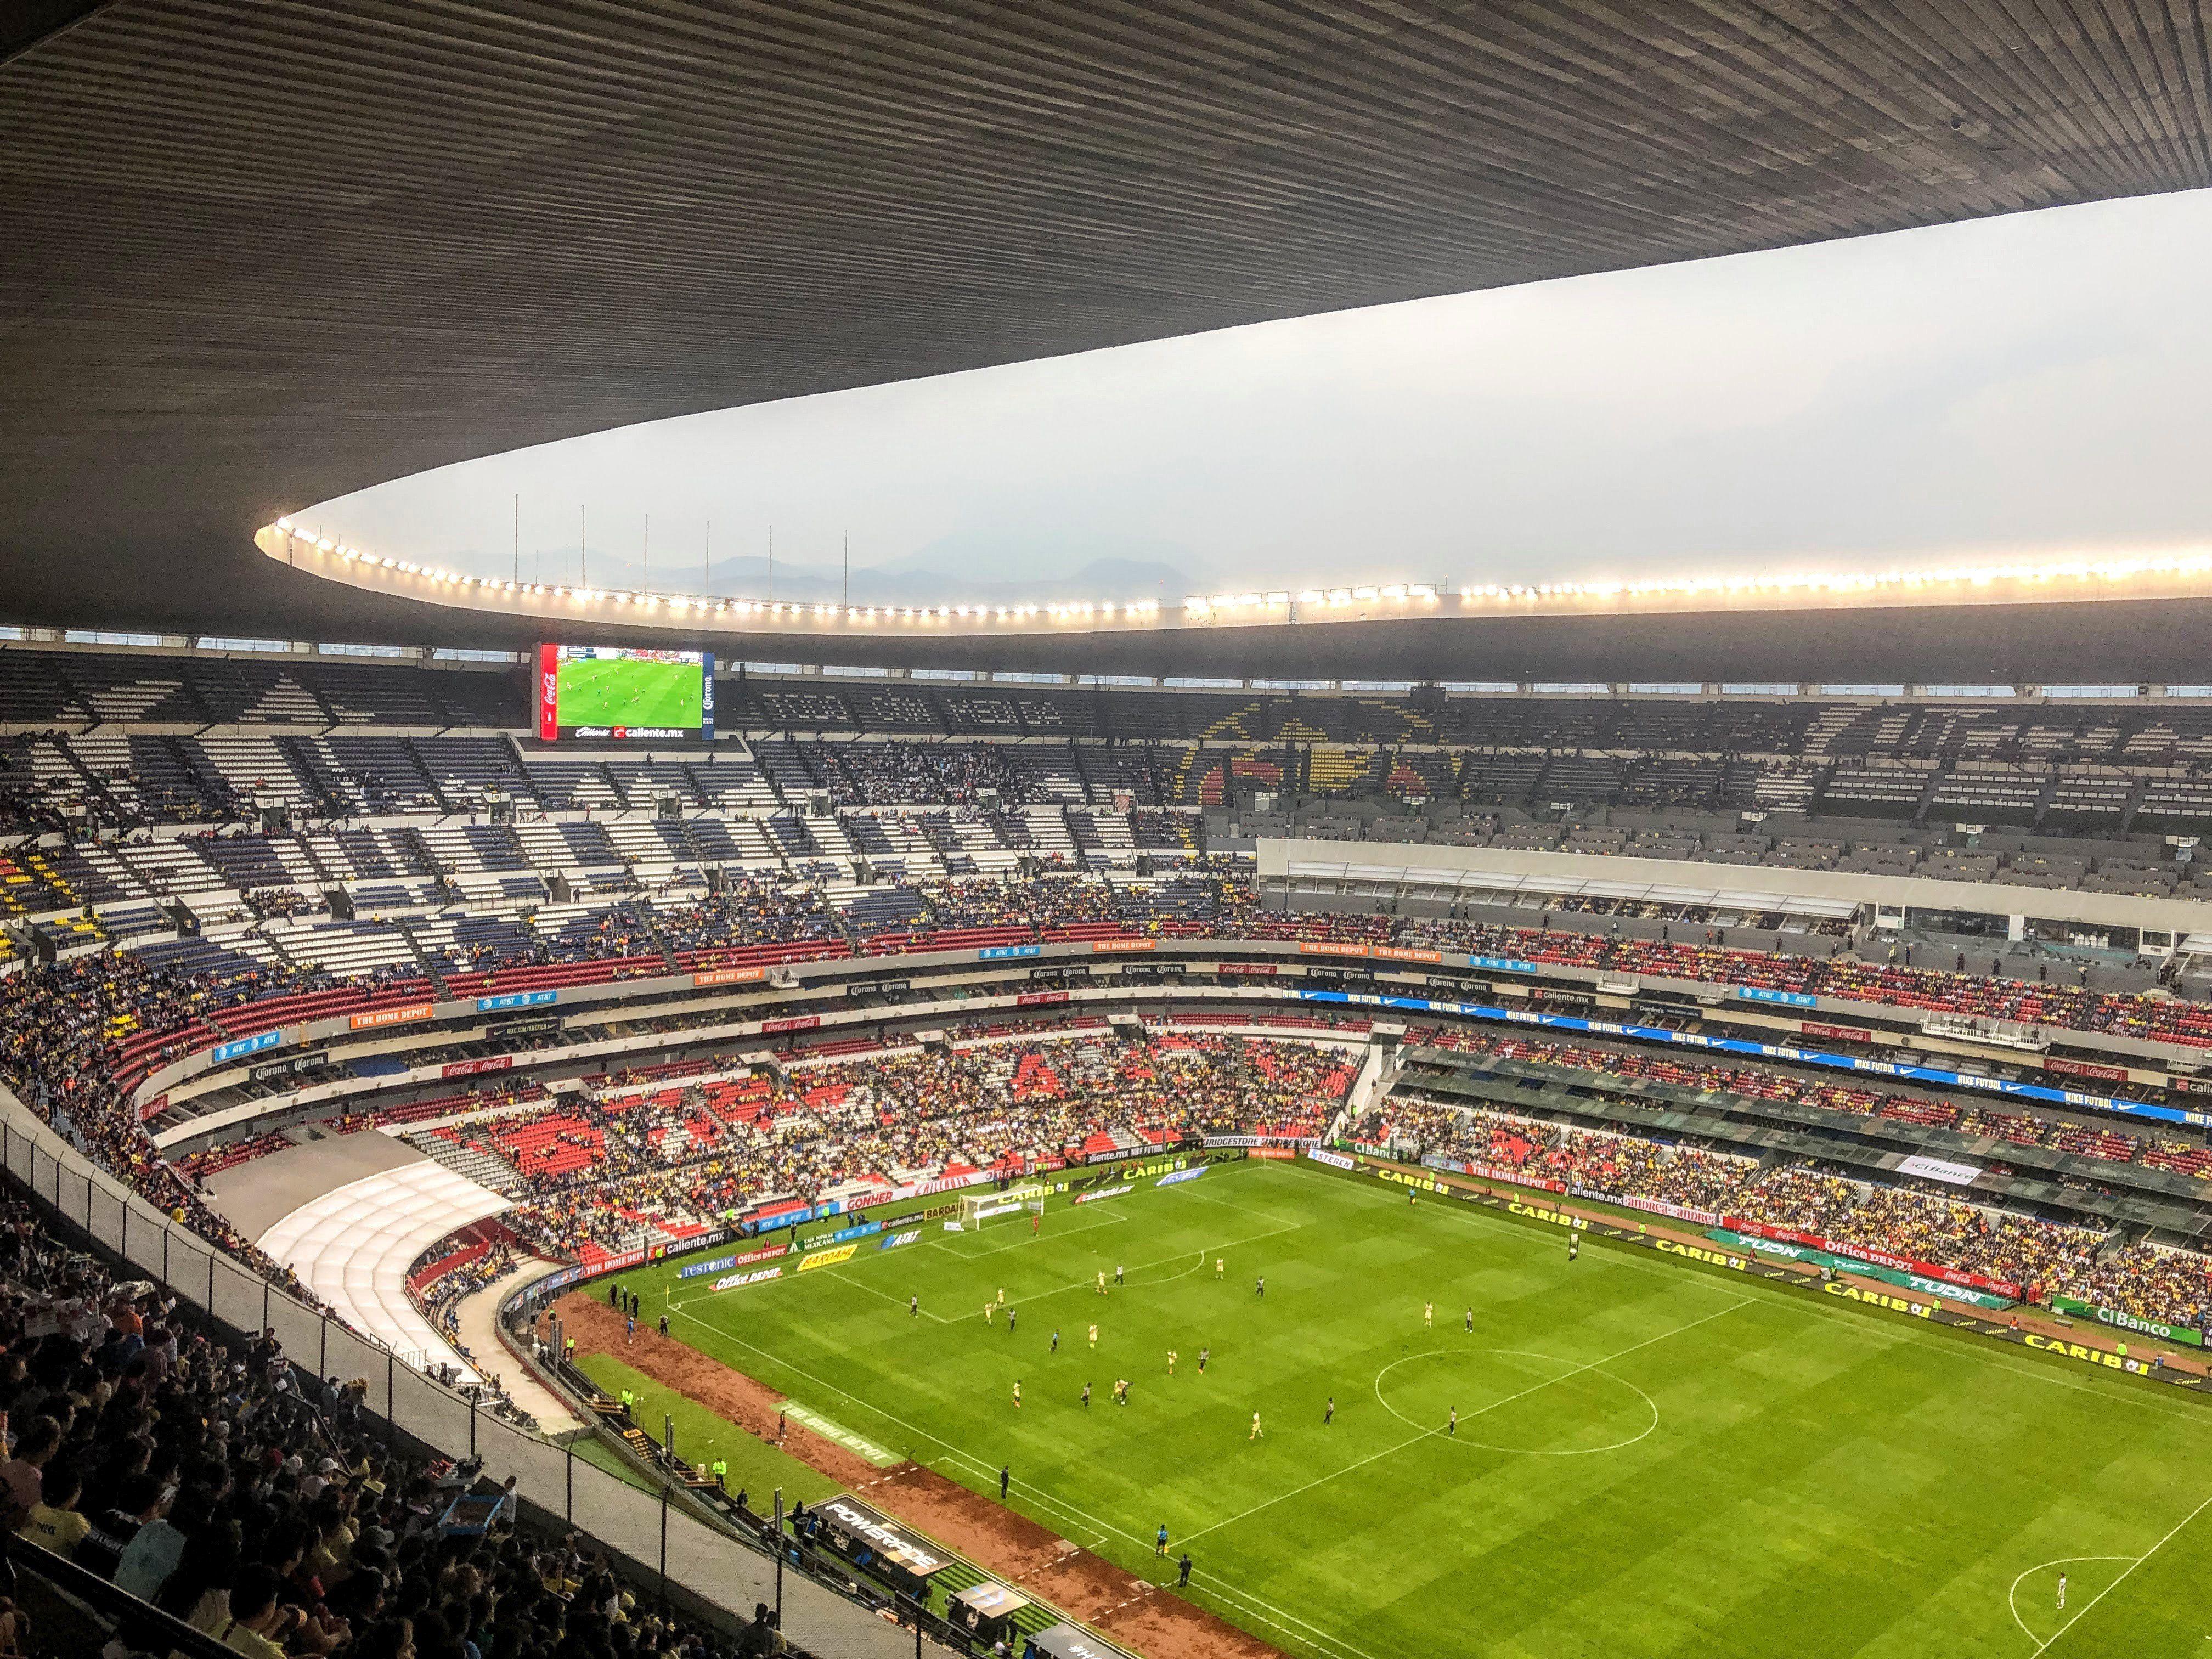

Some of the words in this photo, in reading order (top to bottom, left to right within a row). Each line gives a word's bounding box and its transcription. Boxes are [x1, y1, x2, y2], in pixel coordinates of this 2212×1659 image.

[703, 675, 714, 710] Corona
[625, 727, 684, 738] caliente.mx
[1034, 970, 1057, 979] Corona
[1063, 968, 1086, 978] Corona
[1126, 966, 1151, 974] Corona
[1157, 965, 1182, 974] Corona
[1310, 968, 1337, 978] Corona
[1343, 971, 1370, 981] Corona
[851, 986, 877, 996] Corona
[882, 983, 906, 993] Corona
[1429, 978, 1455, 988] Corona
[1460, 981, 1487, 991] Corona
[499, 998, 515, 1007] AT&T
[537, 993, 552, 1001] AT&T
[1348, 994, 1361, 1002] NIKE
[1543, 991, 1589, 1004] caliente.mx
[1429, 1001, 1442, 1010] NIKE
[376, 1013, 399, 1023] HOME
[402, 1008, 427, 1019] DEPOT
[1506, 1011, 1519, 1020] NIKE
[1588, 1022, 1601, 1030] NIKE
[1672, 1032, 1685, 1042] NIKE
[1763, 1045, 1777, 1054] NIKE
[256, 1065, 287, 1080] Corona
[294, 1057, 323, 1072] Corona
[1855, 1059, 1870, 1070] NIKE
[1957, 1074, 1974, 1086] NIKE
[2065, 1091, 2084, 1104] NIKE
[2186, 1112, 2204, 1126] NIKE
[1317, 1153, 1351, 1167] STEREN
[1472, 1166, 1489, 1176] THE
[1492, 1170, 1515, 1181] HOME
[1517, 1175, 1547, 1189] DEPOT
[847, 1192, 893, 1211] GONHER
[667, 1231, 724, 1254] caliente.mx
[804, 1238, 835, 1250] MEXICANA
[891, 1230, 921, 1247] AT&T
[737, 1252, 762, 1265] Office
[1825, 1241, 1868, 1261] Office
[1869, 1252, 1914, 1273] DEPOT
[716, 1273, 748, 1290] Office
[1909, 1276, 1983, 1303] TUDN
[2097, 1307, 2170, 1338] CIBanco
[823, 1503, 939, 1570] POWERADE
